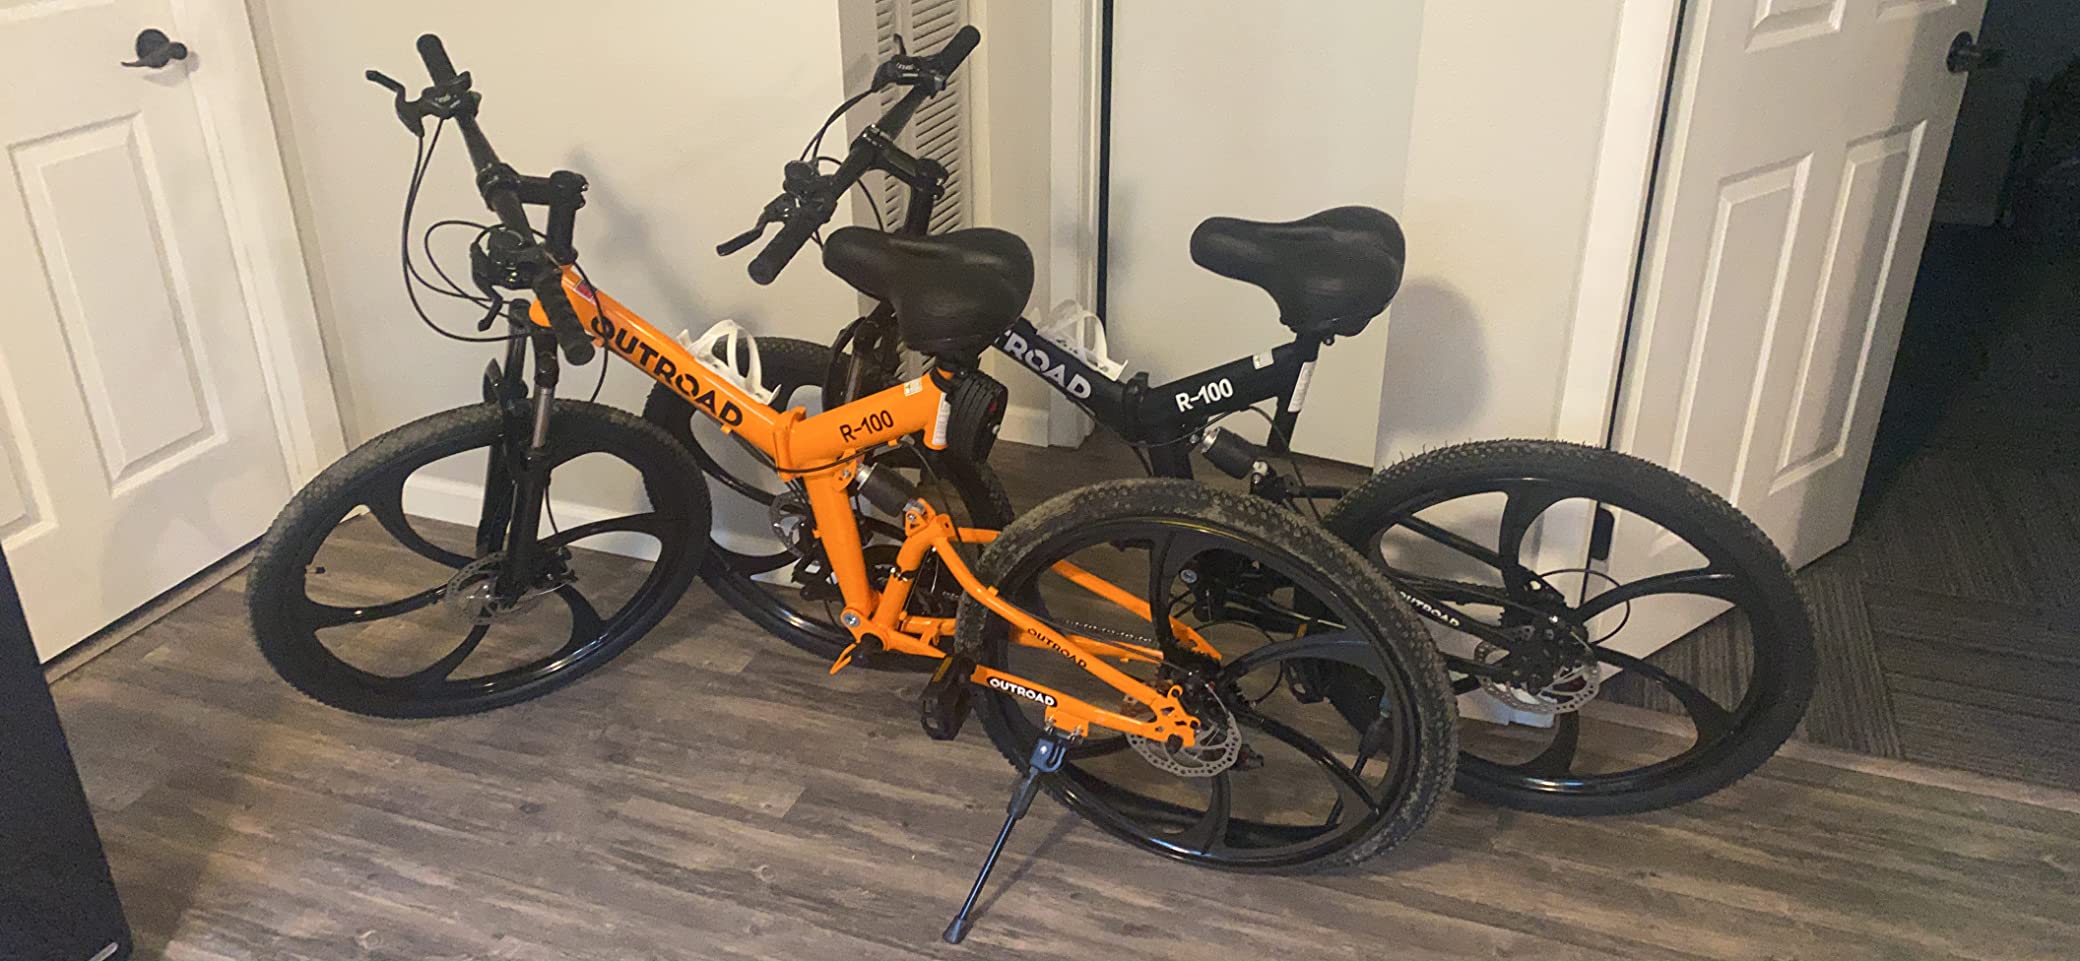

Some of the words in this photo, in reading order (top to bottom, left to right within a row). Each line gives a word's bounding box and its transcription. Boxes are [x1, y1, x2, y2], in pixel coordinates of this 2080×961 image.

[592, 316, 742, 426] OUTROAD
[994, 330, 1091, 399] ROAD
[1175, 377, 1234, 412] R-100
[840, 410, 893, 442] R-100
[1027, 628, 1087, 668] OUTROAD
[989, 678, 1055, 707] OUTROAD
